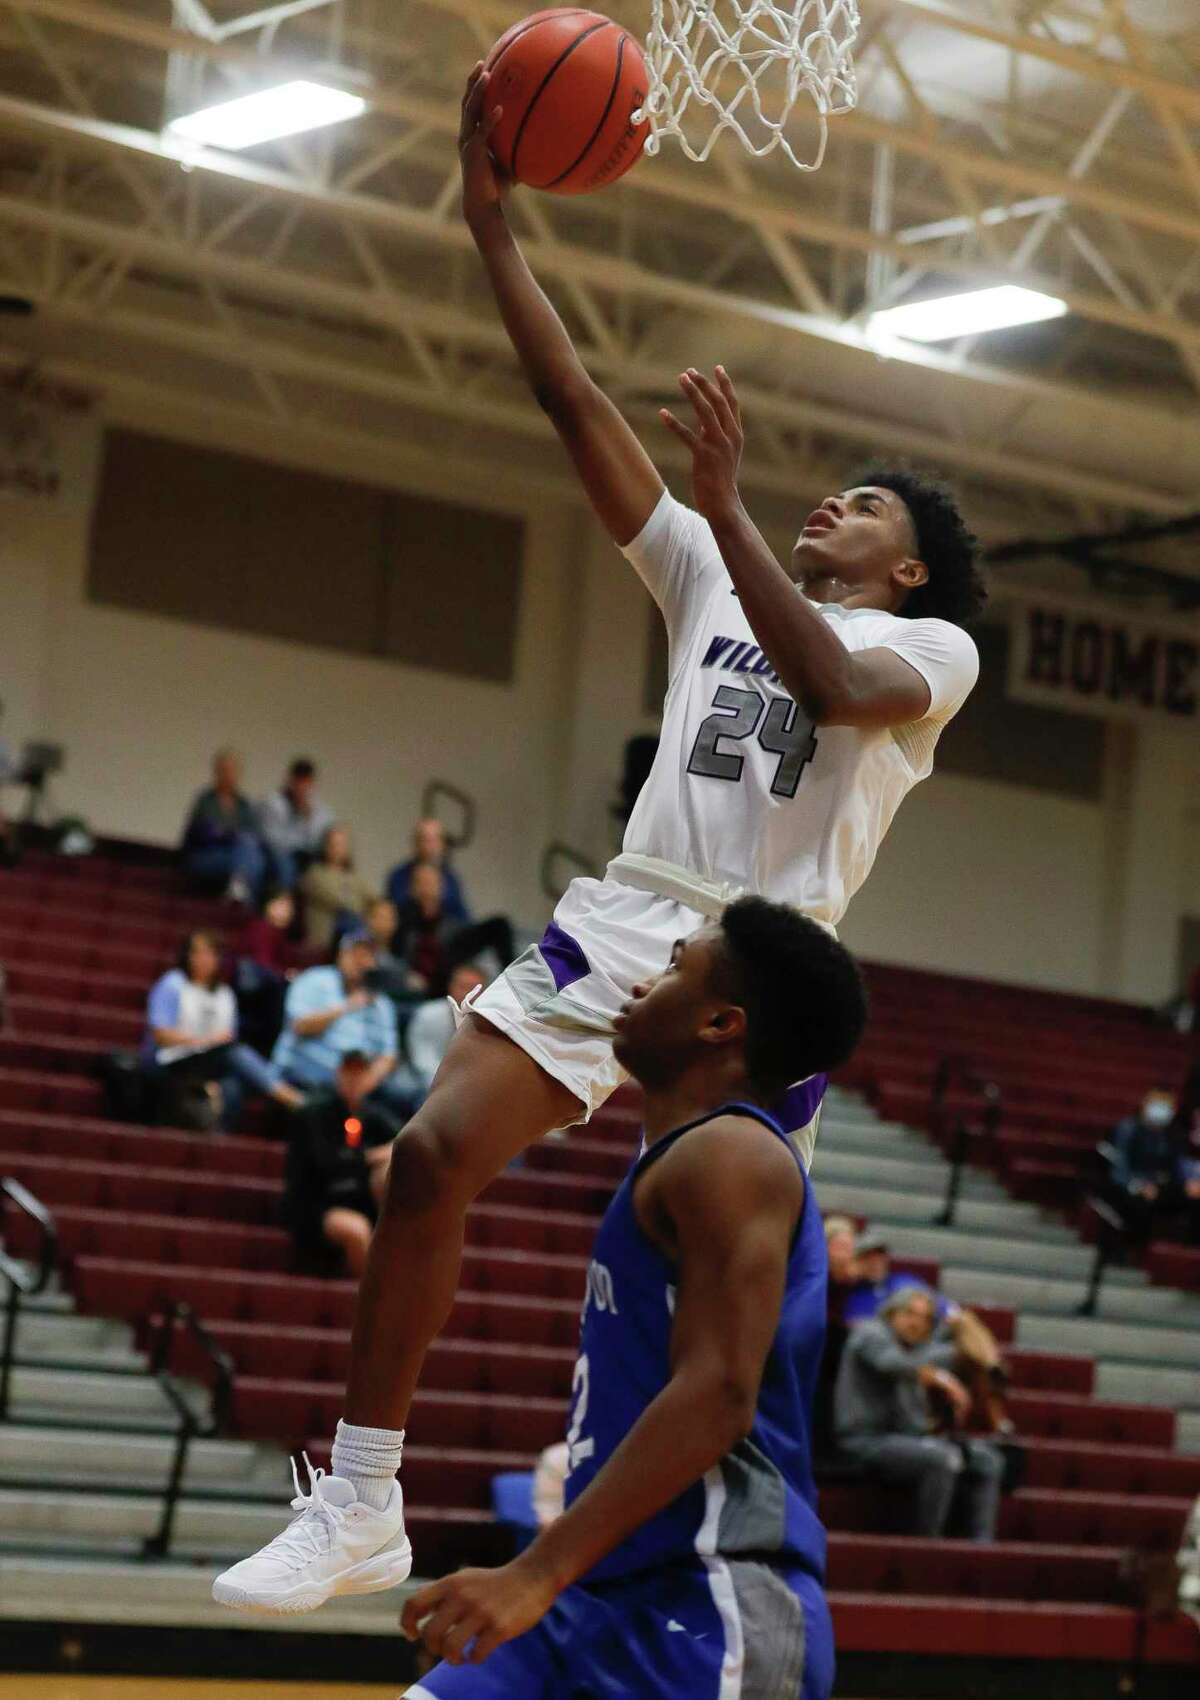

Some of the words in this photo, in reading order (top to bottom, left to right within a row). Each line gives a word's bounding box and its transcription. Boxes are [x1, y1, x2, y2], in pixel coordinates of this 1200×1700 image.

[700, 635, 782, 684] WILD
[1024, 605, 1197, 717] HOME
[686, 684, 818, 799] 24
